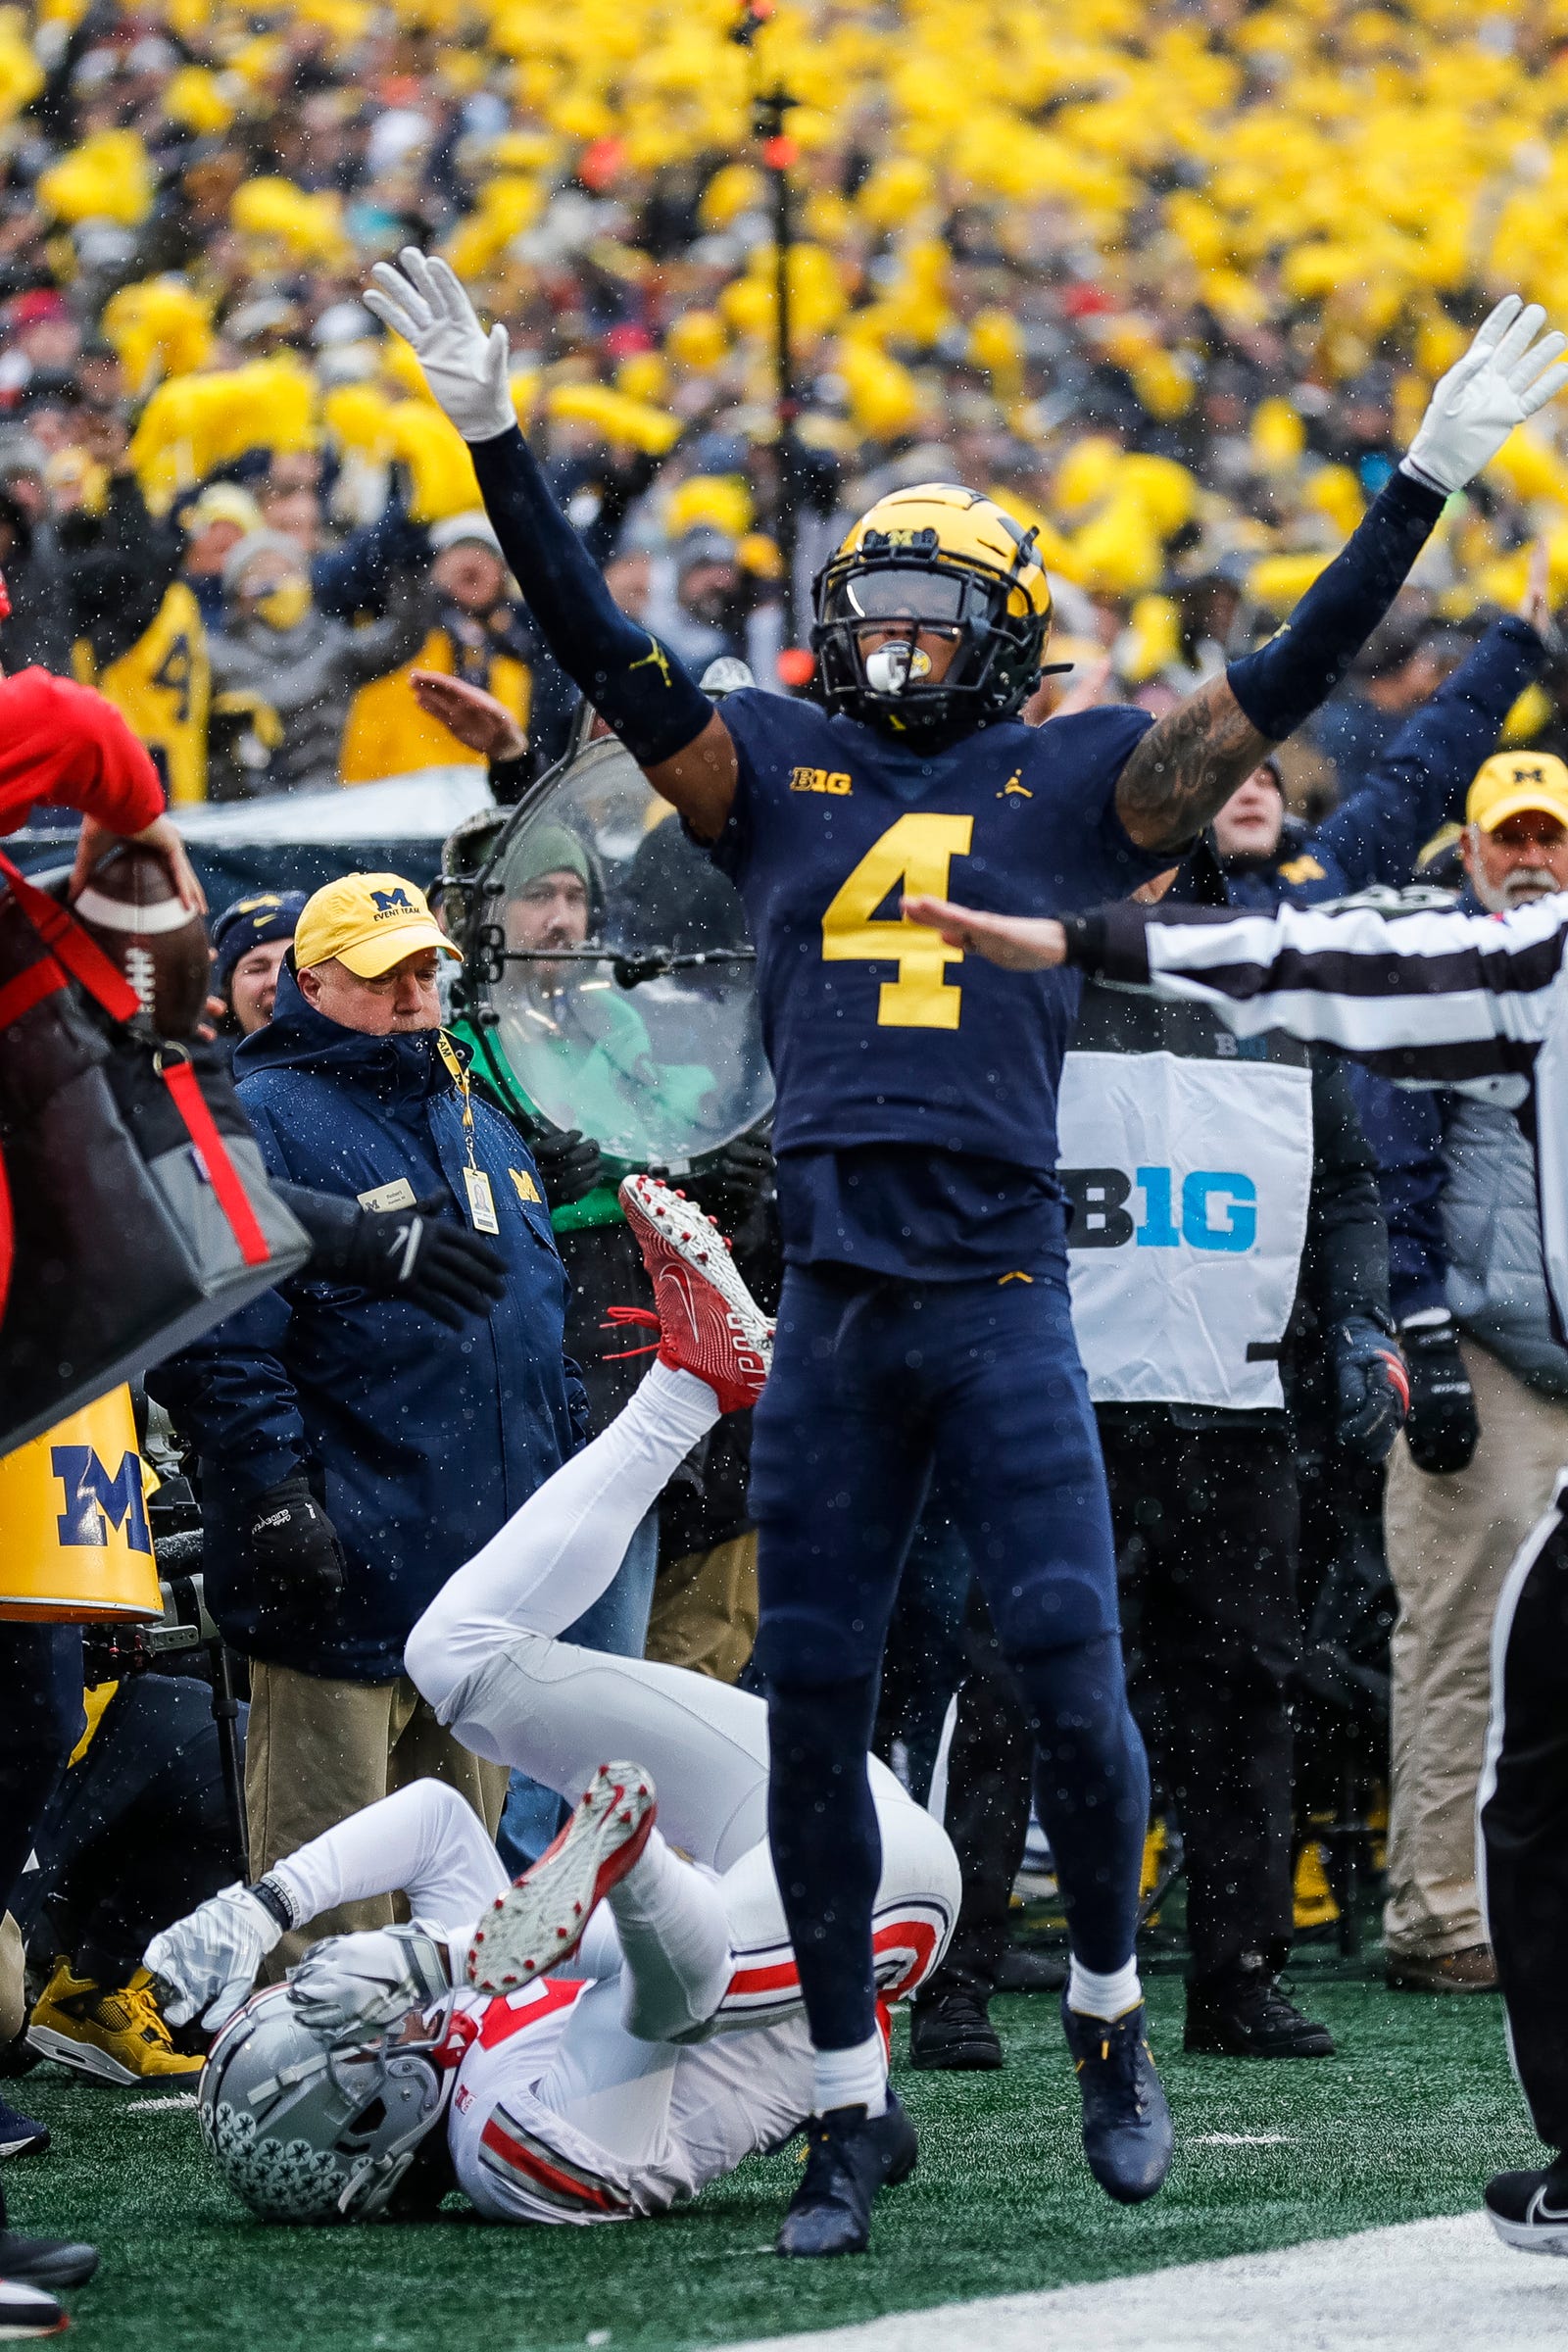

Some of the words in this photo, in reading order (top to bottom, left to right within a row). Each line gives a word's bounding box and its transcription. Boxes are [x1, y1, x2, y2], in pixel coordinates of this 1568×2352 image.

[1513, 768, 1545, 783] M
[369, 888, 414, 911] M
[373, 908, 400, 921] EVENT
[821, 812, 974, 1030] 4
[508, 1168, 543, 1203] M
[51, 1446, 151, 1556] M
